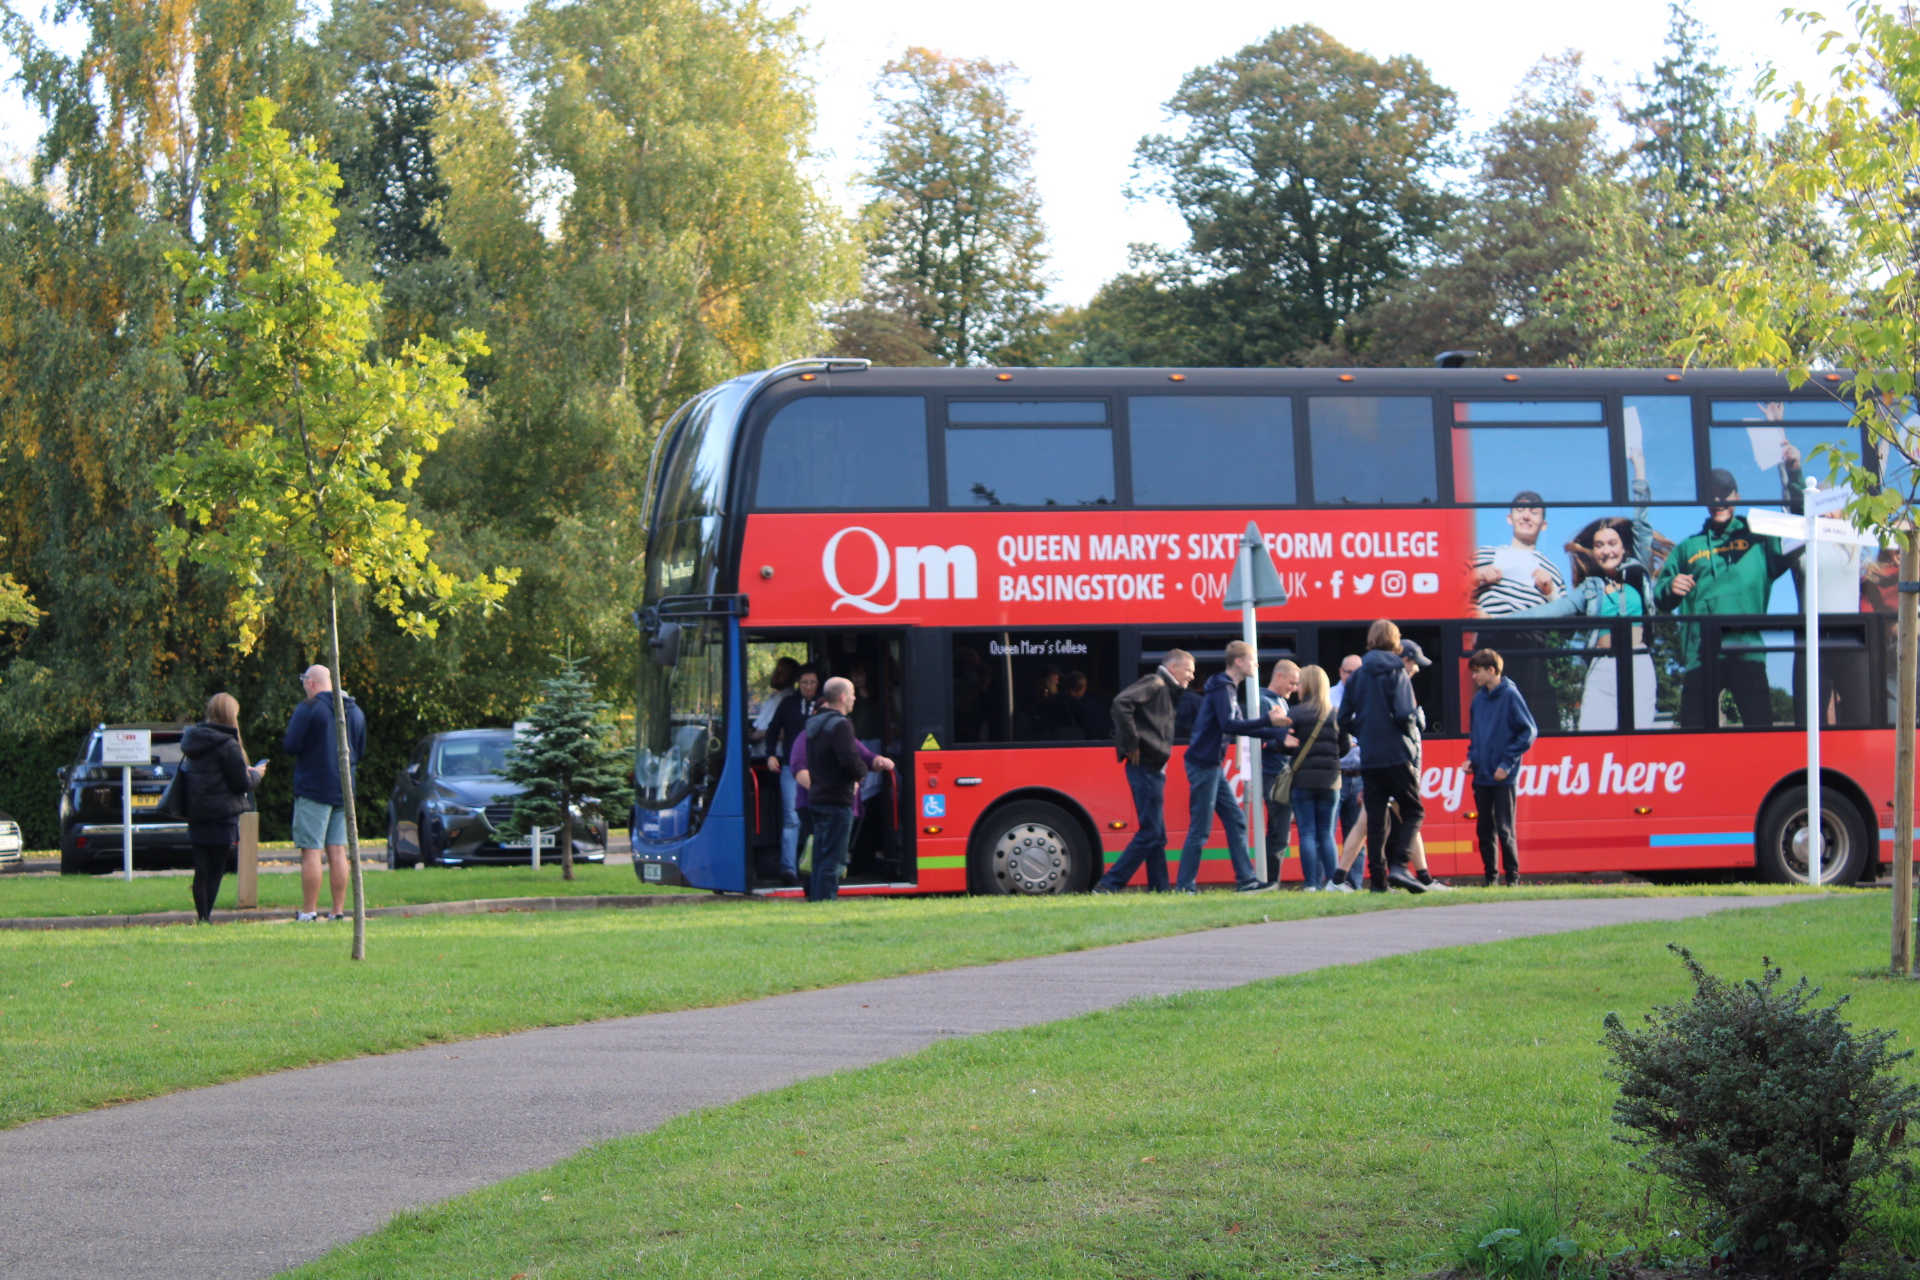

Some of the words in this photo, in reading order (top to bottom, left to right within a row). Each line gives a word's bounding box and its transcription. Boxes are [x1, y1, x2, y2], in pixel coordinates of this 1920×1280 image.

[997, 534, 1081, 567] QUEEN
[1089, 533, 1181, 561] MARY'S
[1187, 533, 1245, 559] SIXT
[1340, 530, 1439, 558] COLLEGE
[821, 526, 978, 615] Qm
[999, 573, 1165, 602] BASINGSTOKE
[989, 640, 1020, 655] Queen
[1515, 755, 1591, 796] arts
[1597, 752, 1686, 795] here
